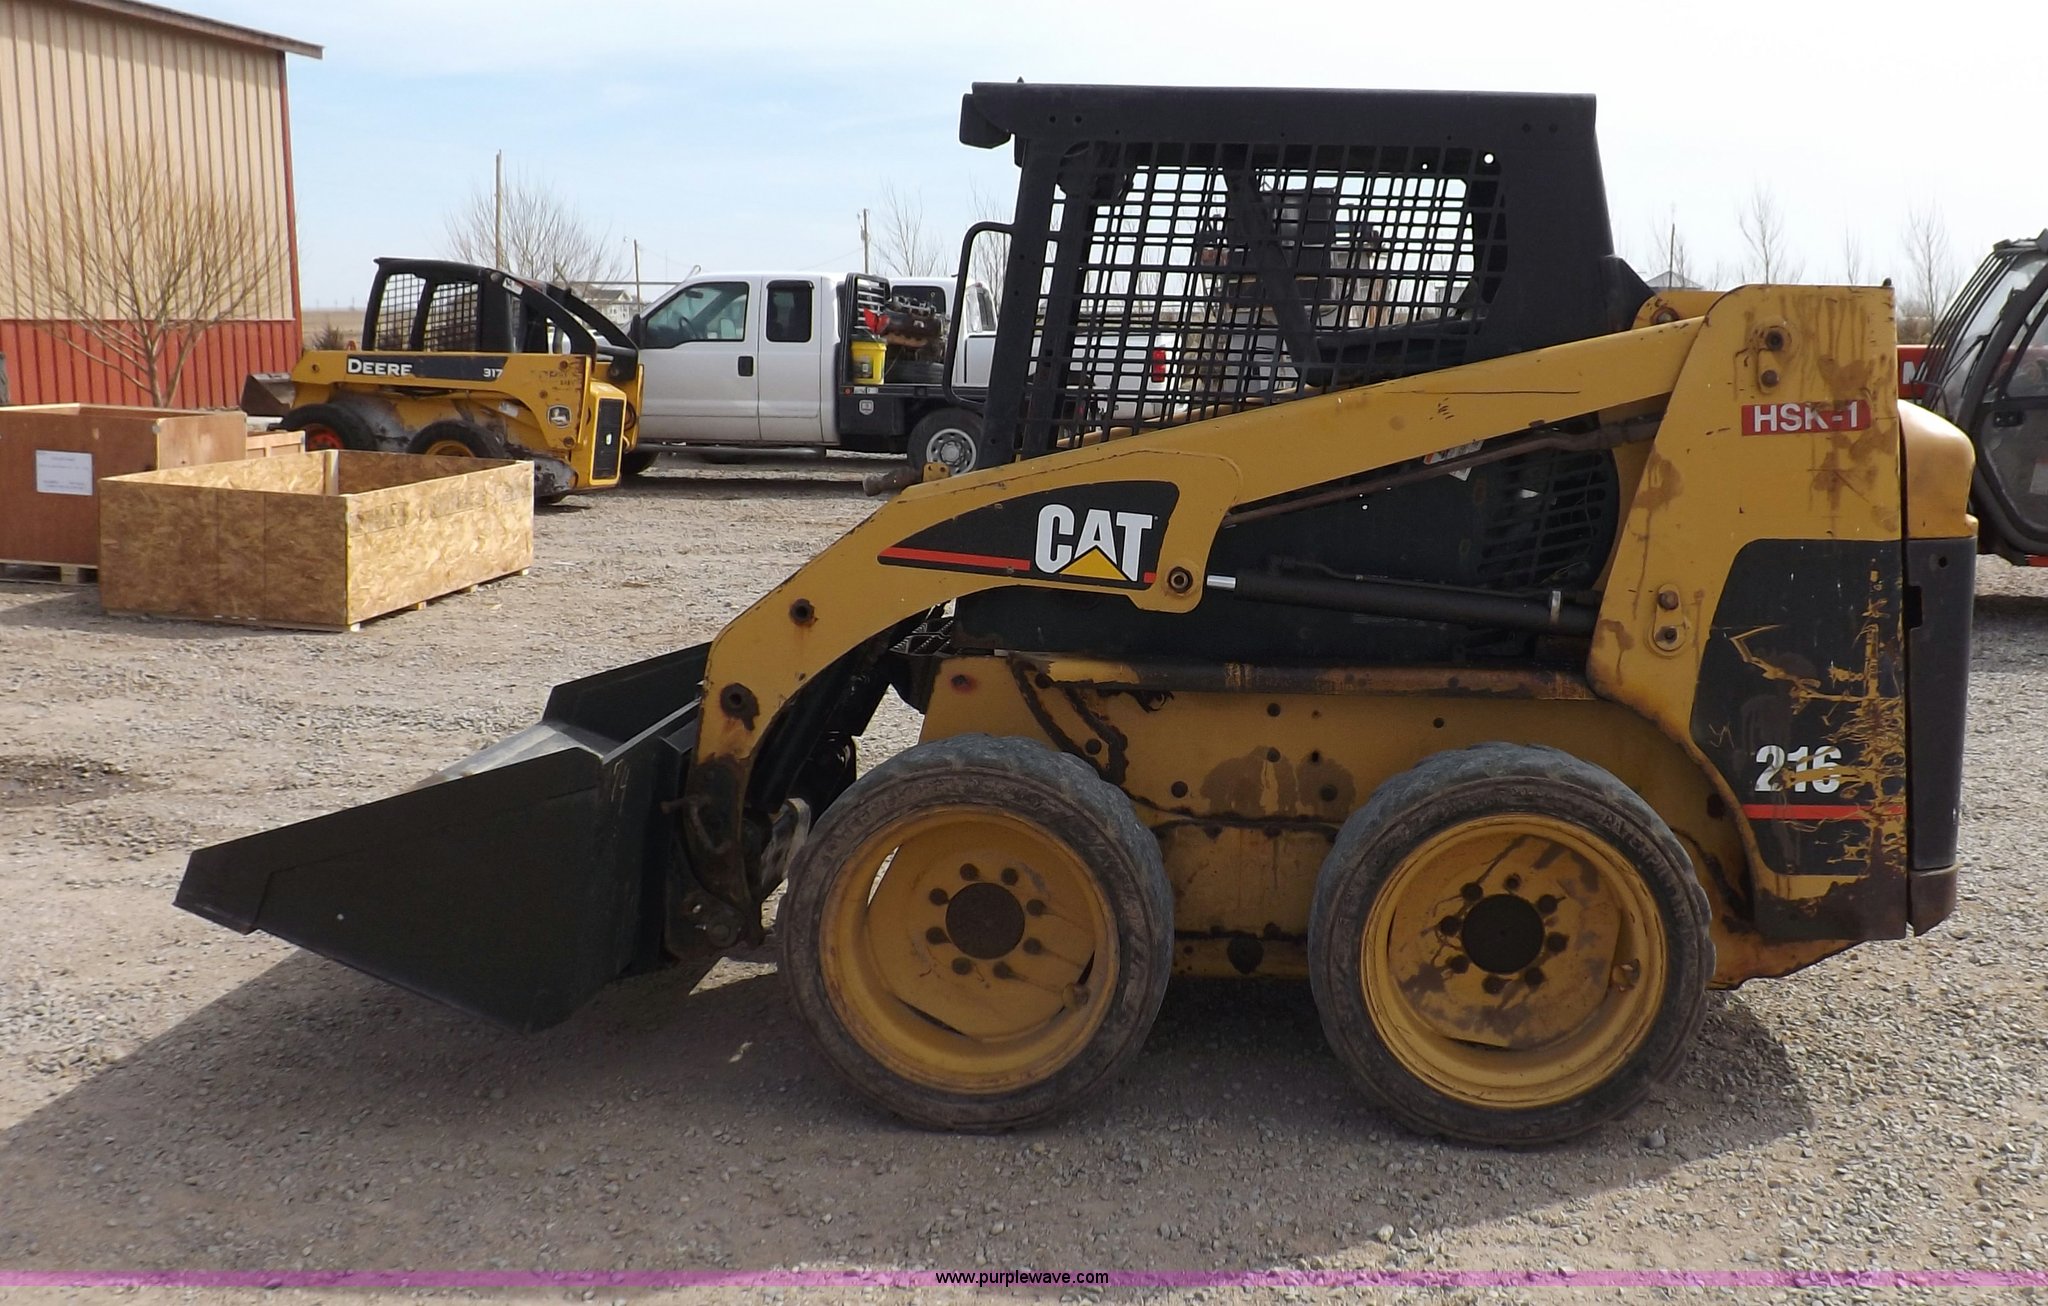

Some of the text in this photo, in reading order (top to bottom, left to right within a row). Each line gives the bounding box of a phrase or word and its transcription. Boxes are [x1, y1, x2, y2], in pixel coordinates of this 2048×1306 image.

[347, 358, 413, 377] DEERE
[483, 368, 503, 378] 317
[1753, 401, 1858, 433] HSK-1
[1035, 503, 1153, 582] CAT
[1754, 745, 1842, 793] 216
